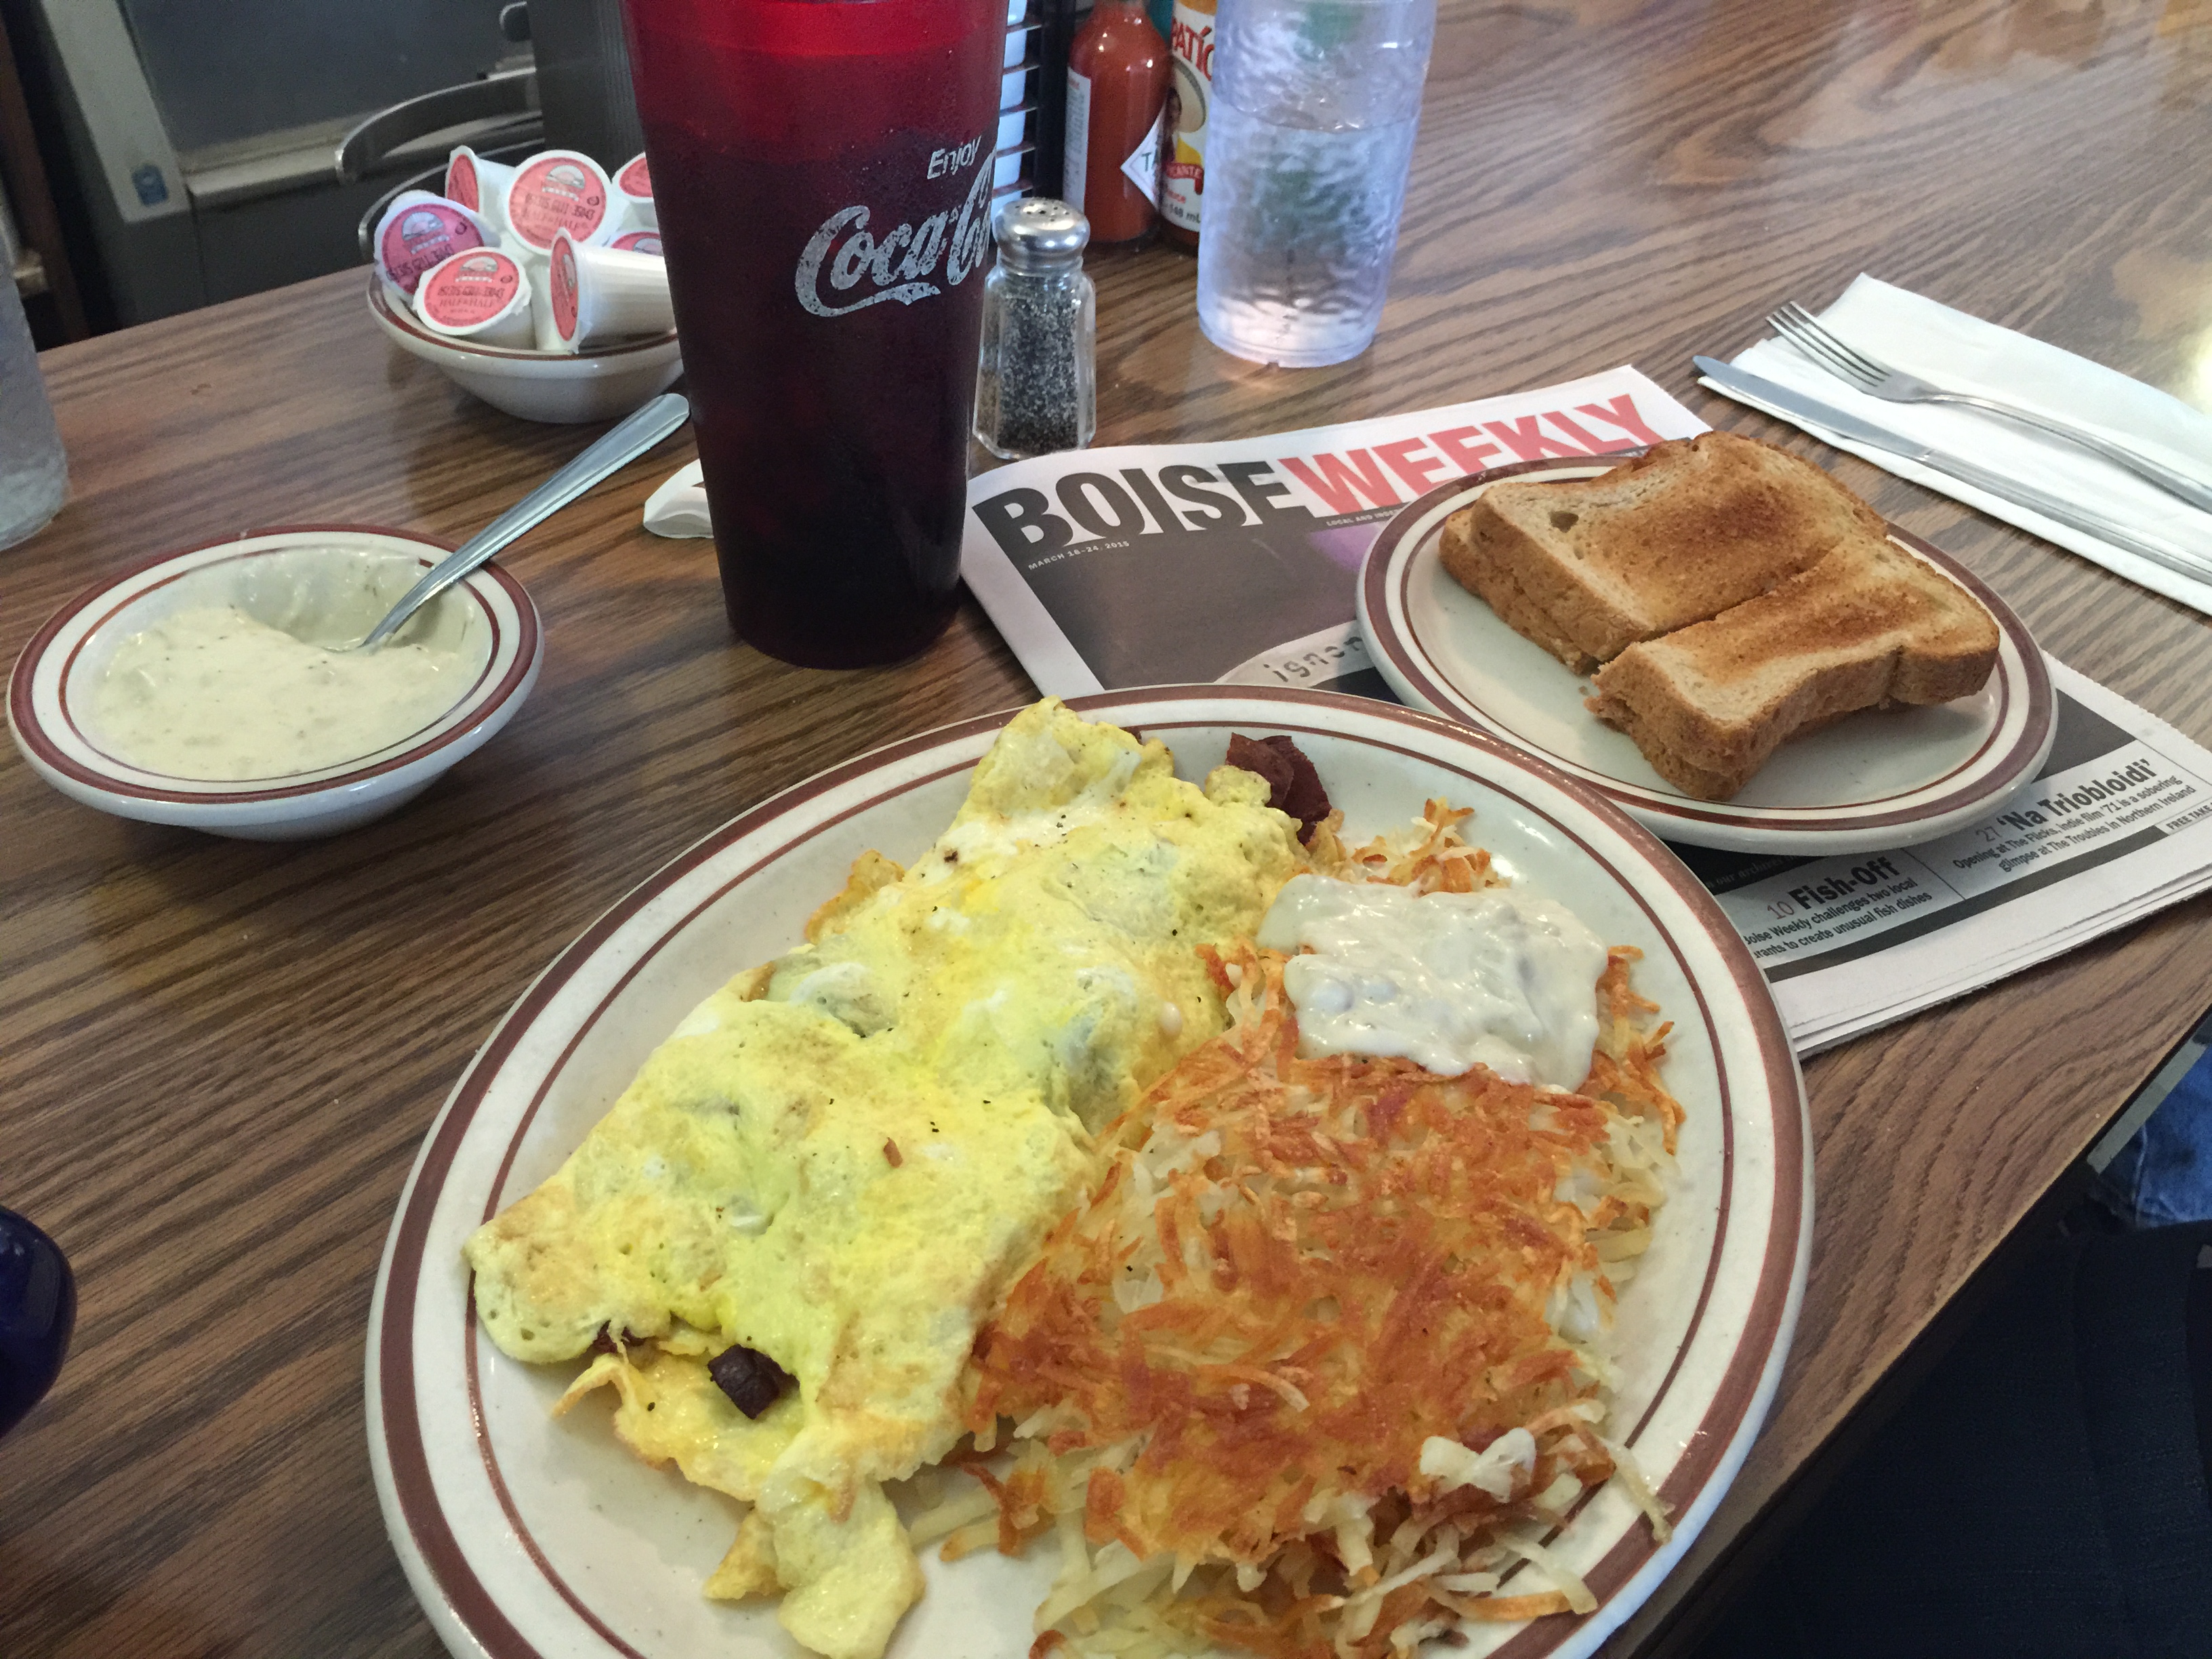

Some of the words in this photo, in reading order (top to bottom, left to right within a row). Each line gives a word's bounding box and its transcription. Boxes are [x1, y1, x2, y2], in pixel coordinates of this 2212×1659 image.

[927, 136, 981, 180] Enjoy
[972, 461, 1313, 550] BOISE
[1277, 392, 1667, 515] WEEKLY
[1028, 553, 1065, 570] MARCH
[1105, 540, 1130, 550] 2015
[1952, 848, 2001, 869] Opening
[1996, 843, 2011, 853] at
[2005, 837, 2029, 851] The
[2024, 827, 2062, 842] Flicks,
[2056, 817, 2085, 832] indie
[2080, 810, 2105, 823] film
[2118, 798, 2132, 807] is
[2129, 795, 2139, 803] a
[2136, 775, 2184, 800] sobering
[1975, 826, 2002, 842] 27
[1999, 851, 2040, 872] glimpse
[2038, 845, 2053, 855] at
[2046, 839, 2070, 851] The
[2065, 824, 2110, 845] Troubles
[2105, 821, 2122, 830] in
[2115, 802, 2164, 826] Northern
[2157, 784, 2197, 806] Ireland
[2165, 815, 2193, 830] FREE
[2188, 804, 2211, 819] TAKE
[1767, 900, 1795, 920] 10
[1788, 855, 1900, 911] Fish-Off
[1769, 918, 1813, 938] Weekly
[1811, 896, 1870, 924] challenges
[1866, 889, 1891, 902] two
[1887, 876, 1919, 894] local
[1783, 940, 1799, 950] to
[1798, 929, 1835, 946] create
[1832, 911, 1878, 935] unusual
[1872, 903, 1899, 918] fish
[1896, 892, 1933, 910] dishes
